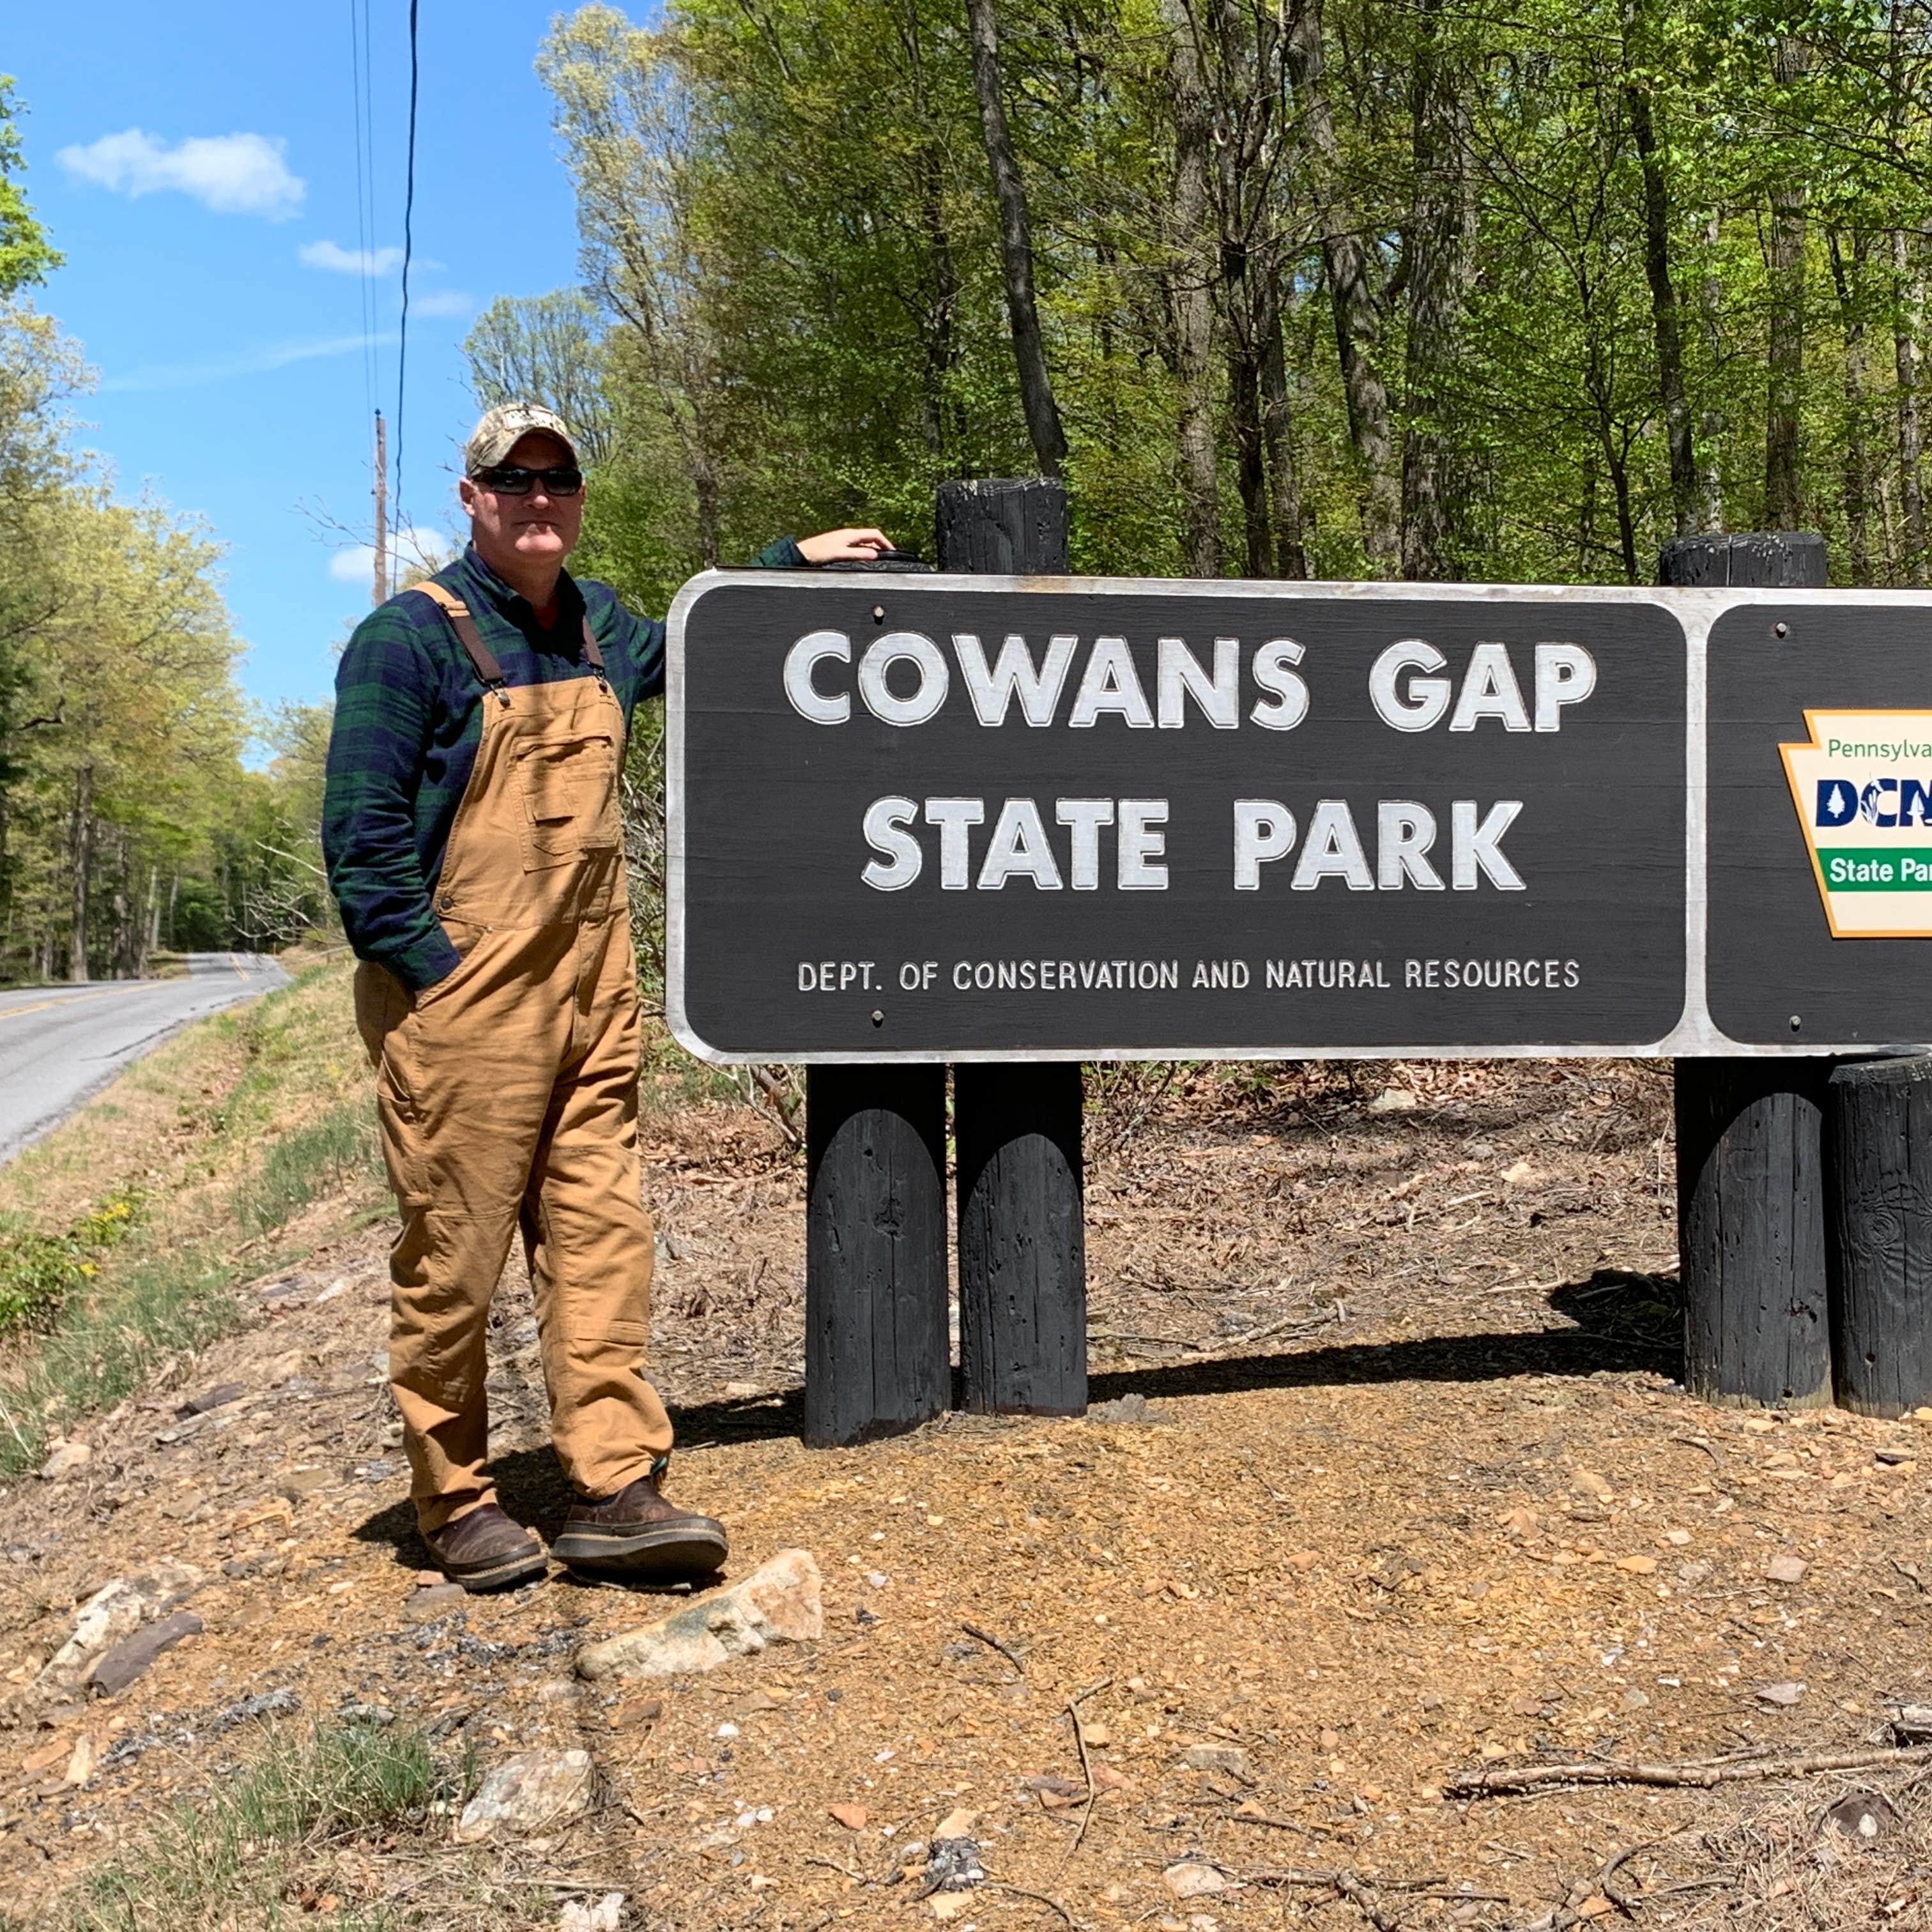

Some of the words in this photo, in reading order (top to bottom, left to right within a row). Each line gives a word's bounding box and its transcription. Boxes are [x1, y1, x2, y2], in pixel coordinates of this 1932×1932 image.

[783, 629, 1310, 731] COWANS
[1368, 638, 1597, 733] GAP
[861, 795, 1169, 892] STATE
[1233, 799, 1527, 891] PARK
[1829, 857, 1894, 883] State
[798, 961, 882, 992] DEPT.
[900, 960, 938, 990] OF
[953, 960, 1178, 990] CONSERVATION
[1192, 960, 1250, 988] AND
[1266, 960, 1391, 988] NATURAL
[1405, 959, 1579, 988] RESOURCES
